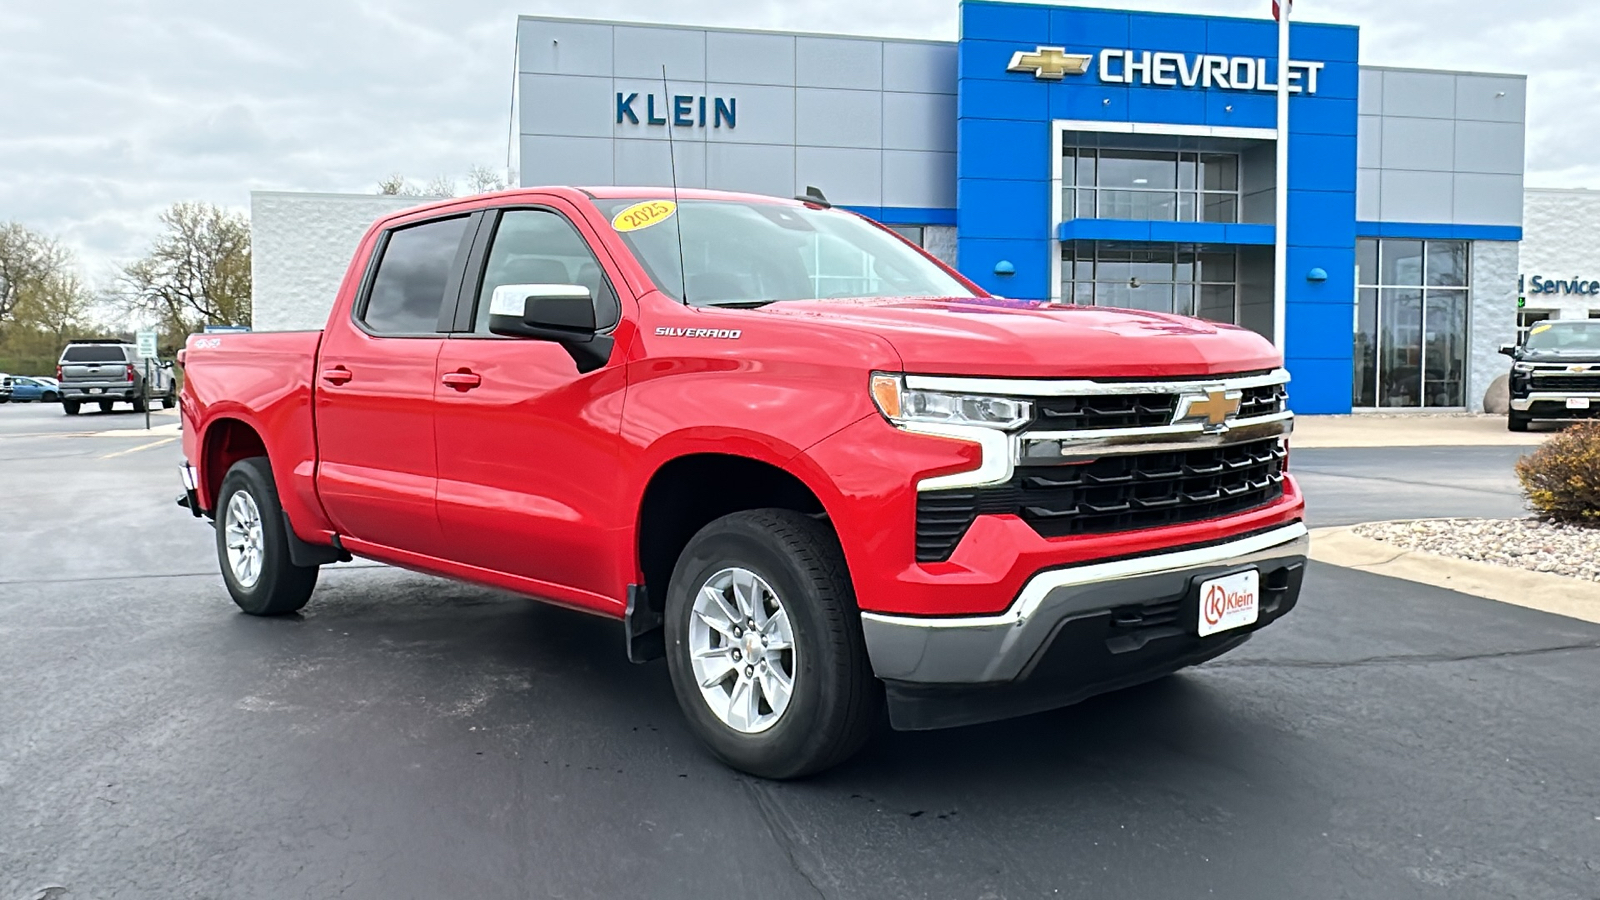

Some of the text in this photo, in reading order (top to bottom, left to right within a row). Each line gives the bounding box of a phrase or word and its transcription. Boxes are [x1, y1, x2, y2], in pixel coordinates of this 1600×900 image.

[1099, 48, 1325, 94] CHEVROLET
[616, 92, 736, 129] KLEIN
[623, 202, 669, 227] 2025
[1531, 275, 1600, 295] Service
[654, 326, 742, 340] SILVERADO
[1226, 592, 1254, 610] Klein
